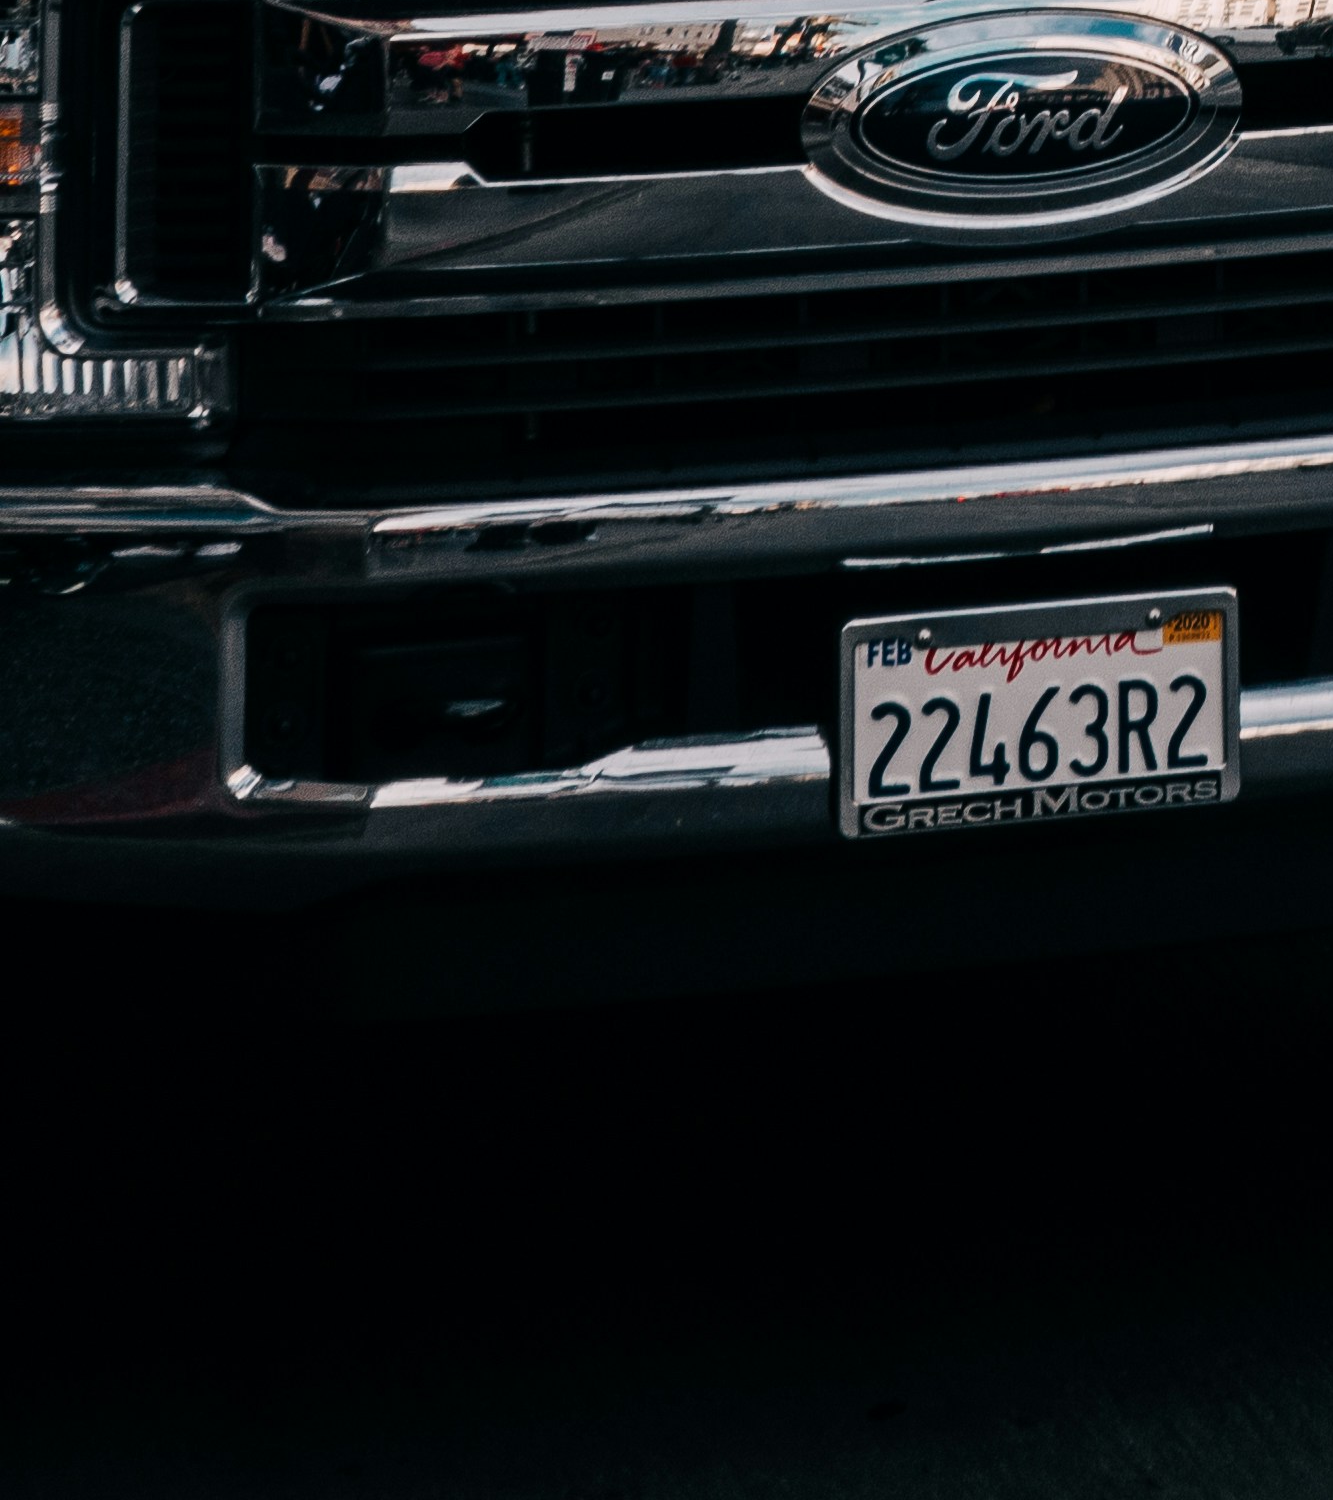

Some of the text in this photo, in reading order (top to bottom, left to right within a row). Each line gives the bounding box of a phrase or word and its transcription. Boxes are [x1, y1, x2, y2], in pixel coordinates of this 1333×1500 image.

[926, 69, 1129, 159] Ford
[1174, 611, 1210, 632] 2020
[866, 637, 913, 669] FEB
[923, 628, 1164, 683] California
[867, 674, 1209, 798] 22463R2
[863, 778, 1218, 832] GRECH MOTORS
